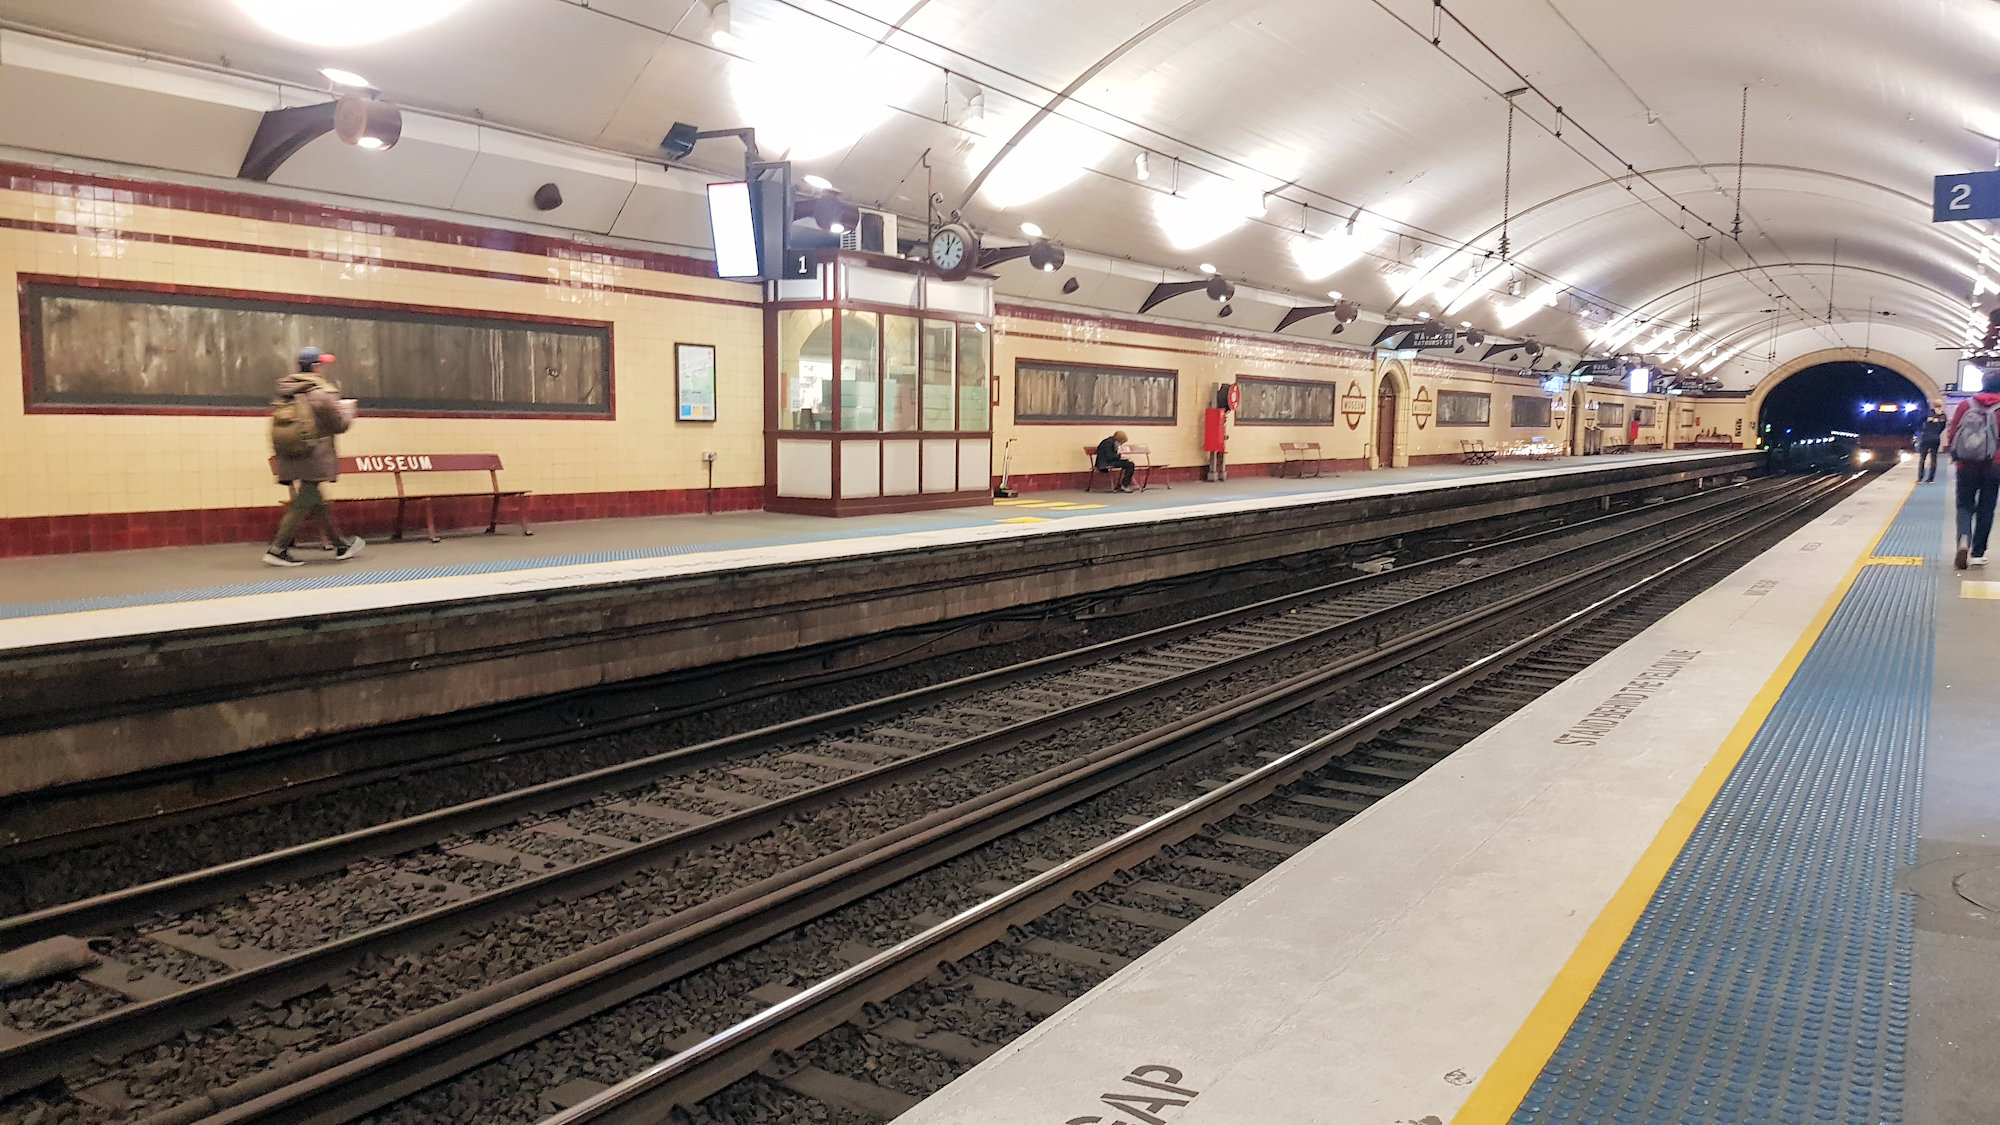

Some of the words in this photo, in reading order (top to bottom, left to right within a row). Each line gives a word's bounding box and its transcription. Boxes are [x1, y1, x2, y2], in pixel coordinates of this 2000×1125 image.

[1949, 183, 1972, 210] 2
[798, 255, 808, 274] 1
[355, 455, 433, 472] MUSEUM
[1553, 718, 1619, 747] STAND
[1587, 693, 1649, 720] BEHIND
[1619, 680, 1665, 693] THE
[1064, 1064, 1200, 1125] AP
